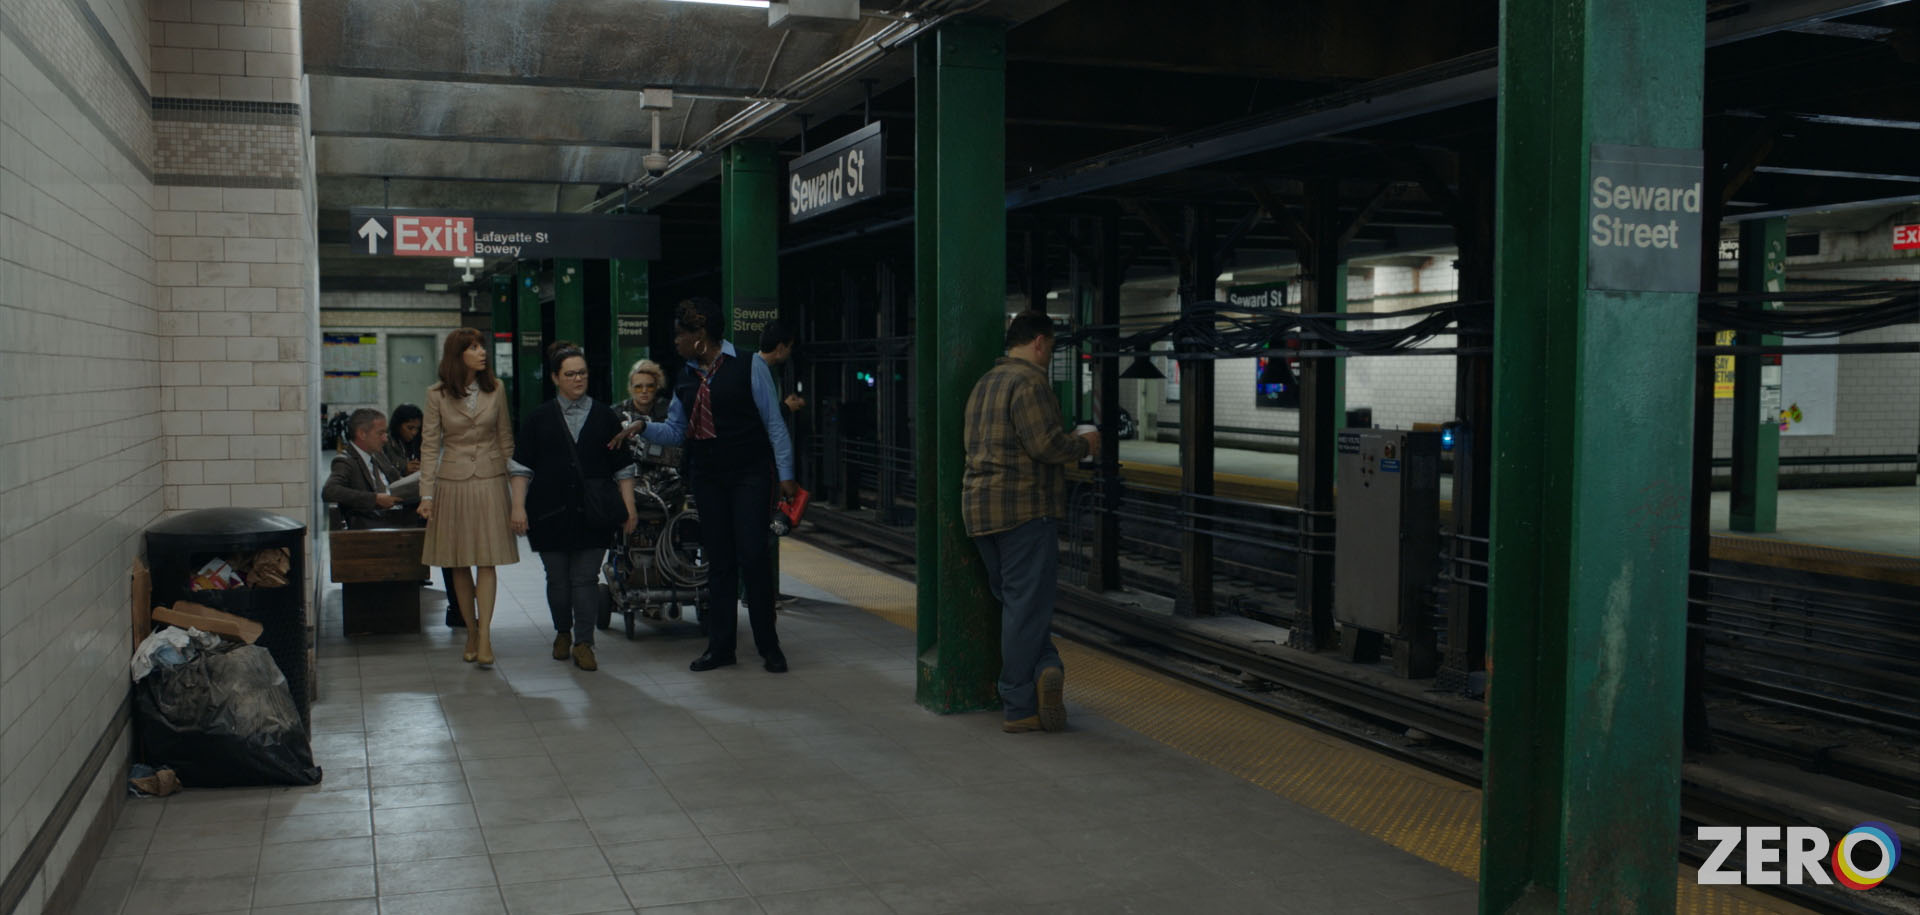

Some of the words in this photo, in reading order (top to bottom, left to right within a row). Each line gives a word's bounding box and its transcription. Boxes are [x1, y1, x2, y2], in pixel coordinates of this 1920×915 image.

[791, 156, 843, 215] Seward
[847, 150, 864, 196] St
[1592, 176, 1702, 213] Seward
[396, 217, 468, 251] Exit
[475, 231, 532, 245] Lafayette
[535, 232, 549, 244] St
[1591, 214, 1679, 249] Street
[475, 243, 522, 258] Bowery
[1230, 290, 1268, 308] Seward
[1270, 289, 1283, 307] St
[733, 307, 778, 320] Seward
